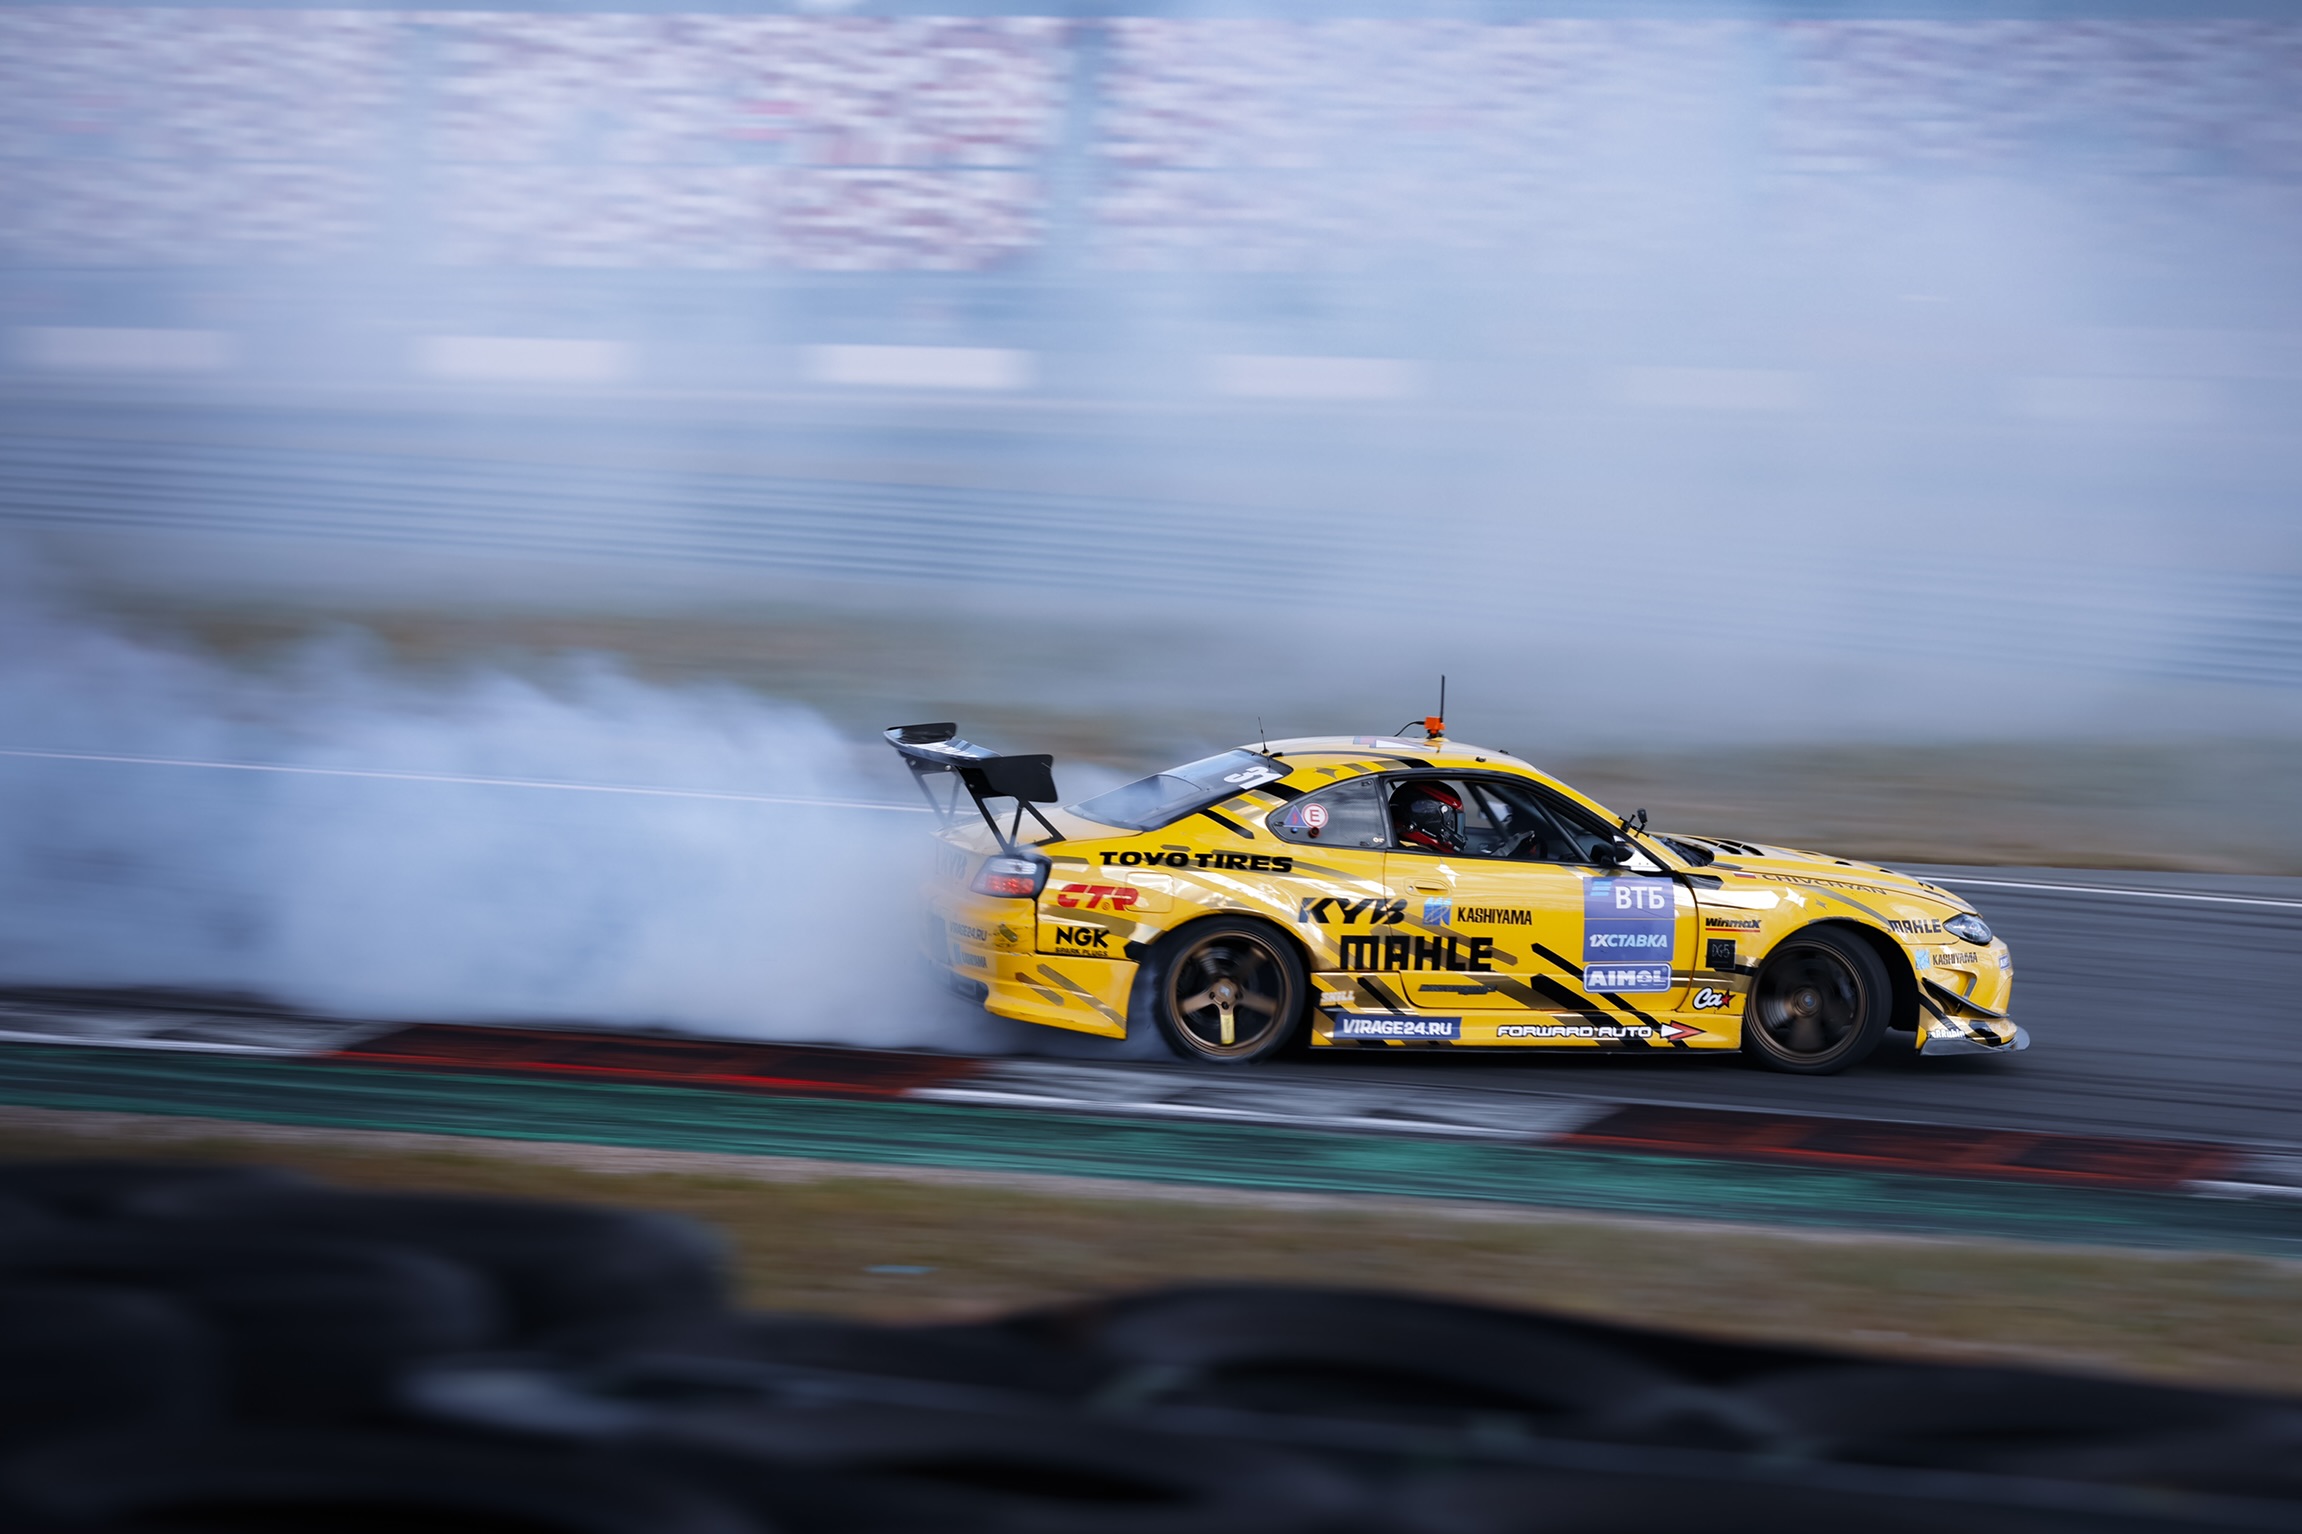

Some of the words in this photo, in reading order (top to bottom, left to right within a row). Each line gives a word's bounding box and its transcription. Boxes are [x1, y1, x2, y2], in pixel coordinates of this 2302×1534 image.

[1309, 809, 1321, 823] E
[1099, 851, 1190, 867] TOYO
[1194, 853, 1293, 873] TIRES
[1761, 874, 1887, 896] CHIVCHYAN
[1057, 884, 1139, 911] CTR
[1615, 886, 1665, 910] ВТБ
[1298, 897, 1408, 925] KYB
[1457, 906, 1533, 926] KASHIYAMA
[1055, 926, 1110, 949] NGK
[1887, 919, 1942, 934] MAHLE
[1340, 935, 1494, 971] MAHLE
[1587, 970, 1667, 987] AIMOL
[1342, 1018, 1453, 1036] VIRAGE24.RU
[1497, 1025, 1595, 1039] FORWARD
[1598, 1025, 1653, 1039] AUTO
